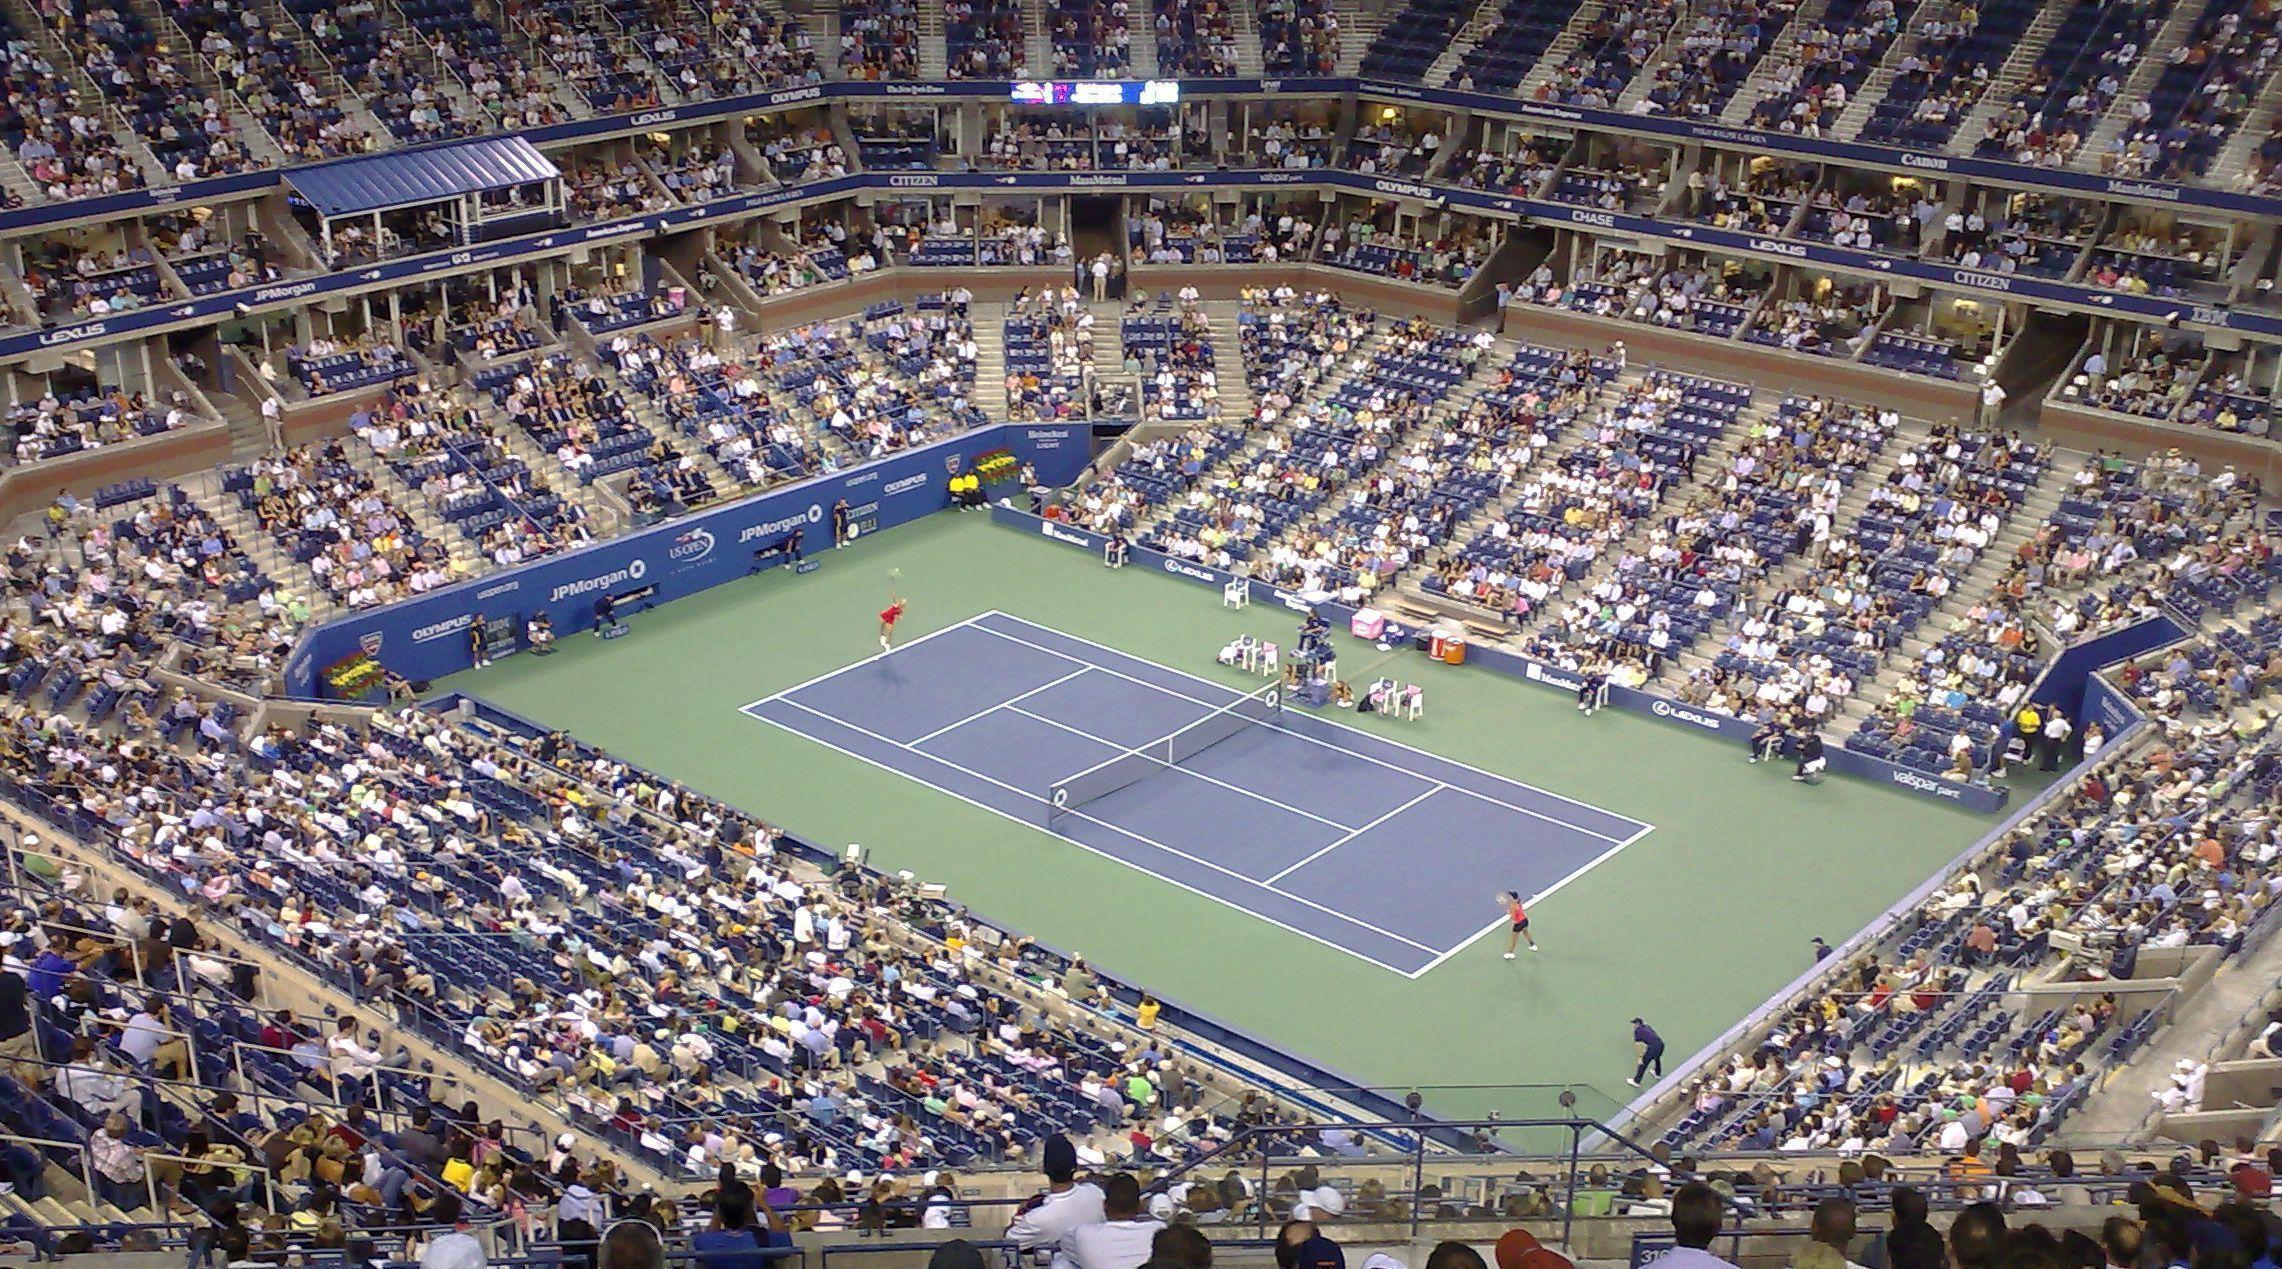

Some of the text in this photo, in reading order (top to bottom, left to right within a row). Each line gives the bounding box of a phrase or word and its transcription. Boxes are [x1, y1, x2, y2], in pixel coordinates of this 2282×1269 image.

[770, 87, 821, 104] OLYMPUS
[630, 110, 676, 126] LEXUS
[1901, 152, 1948, 170] Canon
[890, 175, 938, 186] CITIZEN
[1376, 180, 1433, 198] OLYMPUS
[1572, 210, 1616, 227] CHASE
[1749, 238, 1807, 257] LEXUS
[1953, 271, 2011, 291] CITIZEN
[255, 282, 316, 302] JPMorgan
[2191, 307, 2229, 327] IBM
[40, 323, 106, 345] LEXUS
[883, 473, 927, 493] OLYMPUS
[738, 513, 807, 543] JPMorgan
[1177, 566, 1215, 582] LEXUS
[550, 569, 628, 602] JPMorgan
[412, 614, 473, 641] OLYMPUS
[1670, 708, 1720, 729] LEXUS
[1894, 770, 1939, 791] valspar
